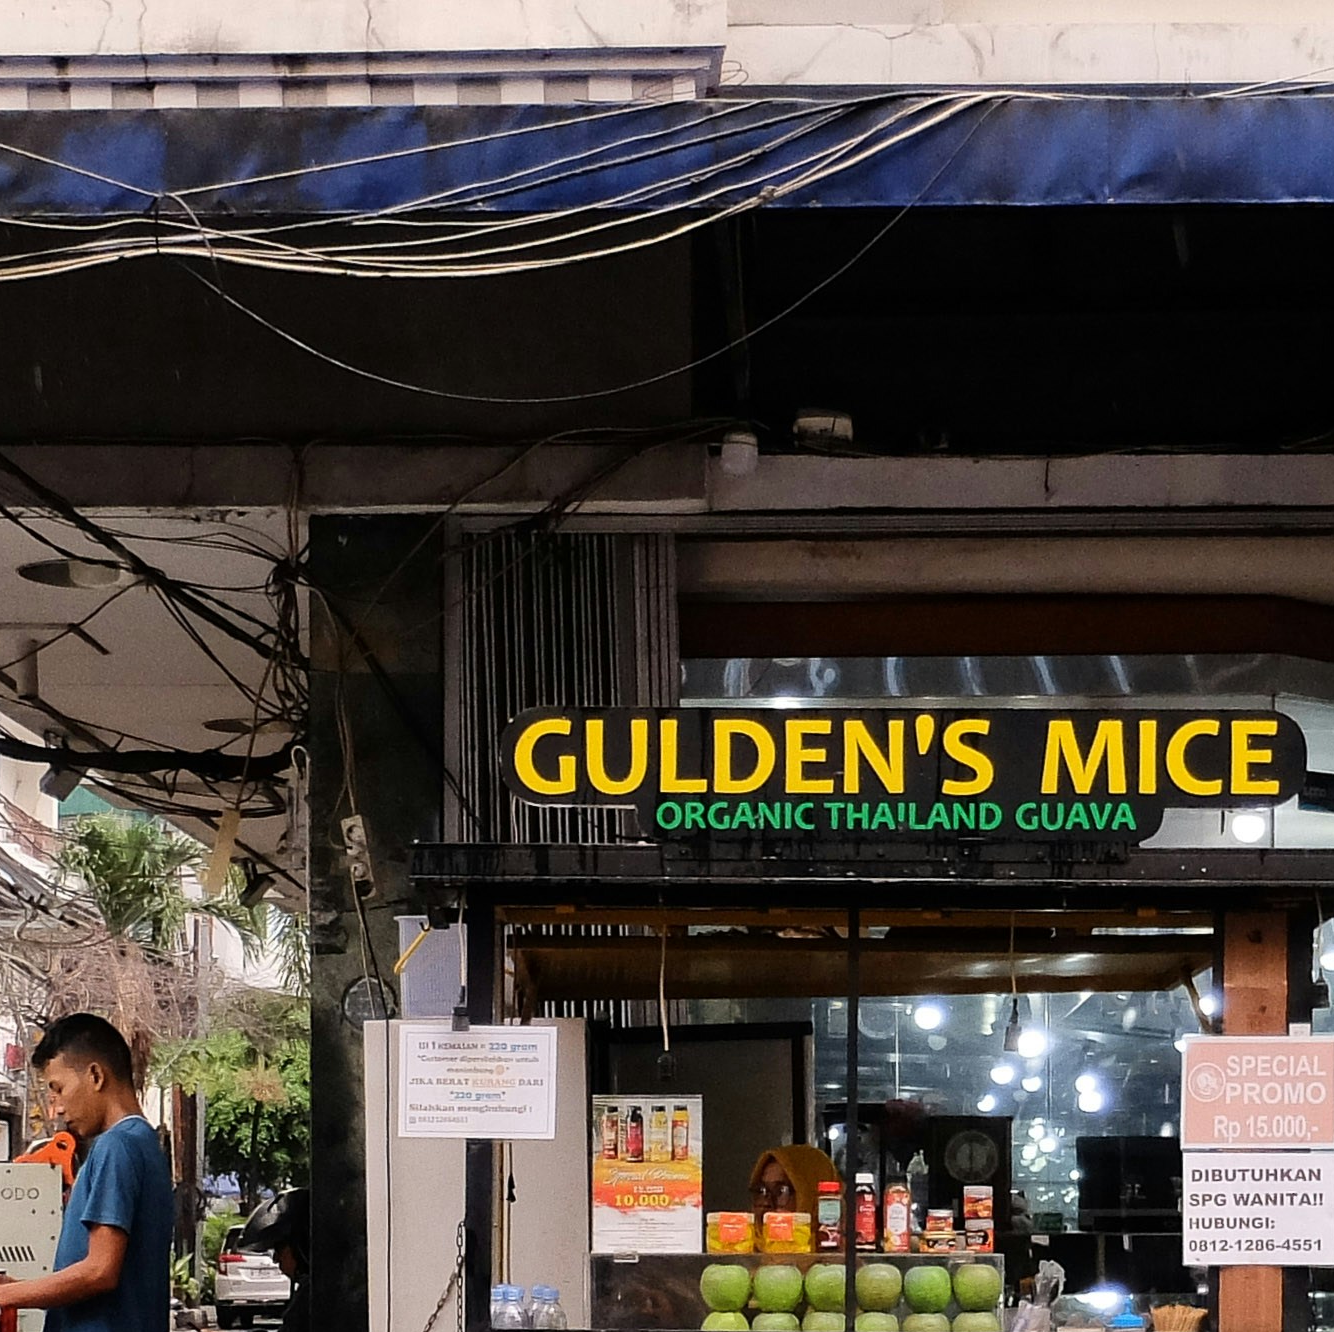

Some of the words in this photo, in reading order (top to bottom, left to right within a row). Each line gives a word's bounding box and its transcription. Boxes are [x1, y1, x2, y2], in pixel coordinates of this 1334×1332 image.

[513, 714, 993, 797] GULDEN'S
[1040, 717, 1281, 797] MICE
[656, 801, 815, 831] ORGANIC
[1014, 801, 1137, 831] GUAVA
[510, 1042, 538, 1053] gram
[1226, 1055, 1326, 1077] SPECIAL
[409, 1078, 434, 1086] JIKA
[436, 1078, 470, 1086] BERAT
[518, 1078, 544, 1086] DARI
[1225, 1082, 1327, 1105] PROMO
[1214, 1115, 1241, 1143] Rp
[1247, 1115, 1319, 1141] 15.000,-
[1191, 1168, 1322, 1182] DIBUTUHKAN
[614, 1194, 670, 1207] 10.000
[1189, 1193, 1227, 1207] SPG
[1233, 1192, 1324, 1206] WANITA!!
[1189, 1217, 1276, 1230] HUBUNGI:
[1189, 1238, 1323, 1252] 0812-1286-4551
